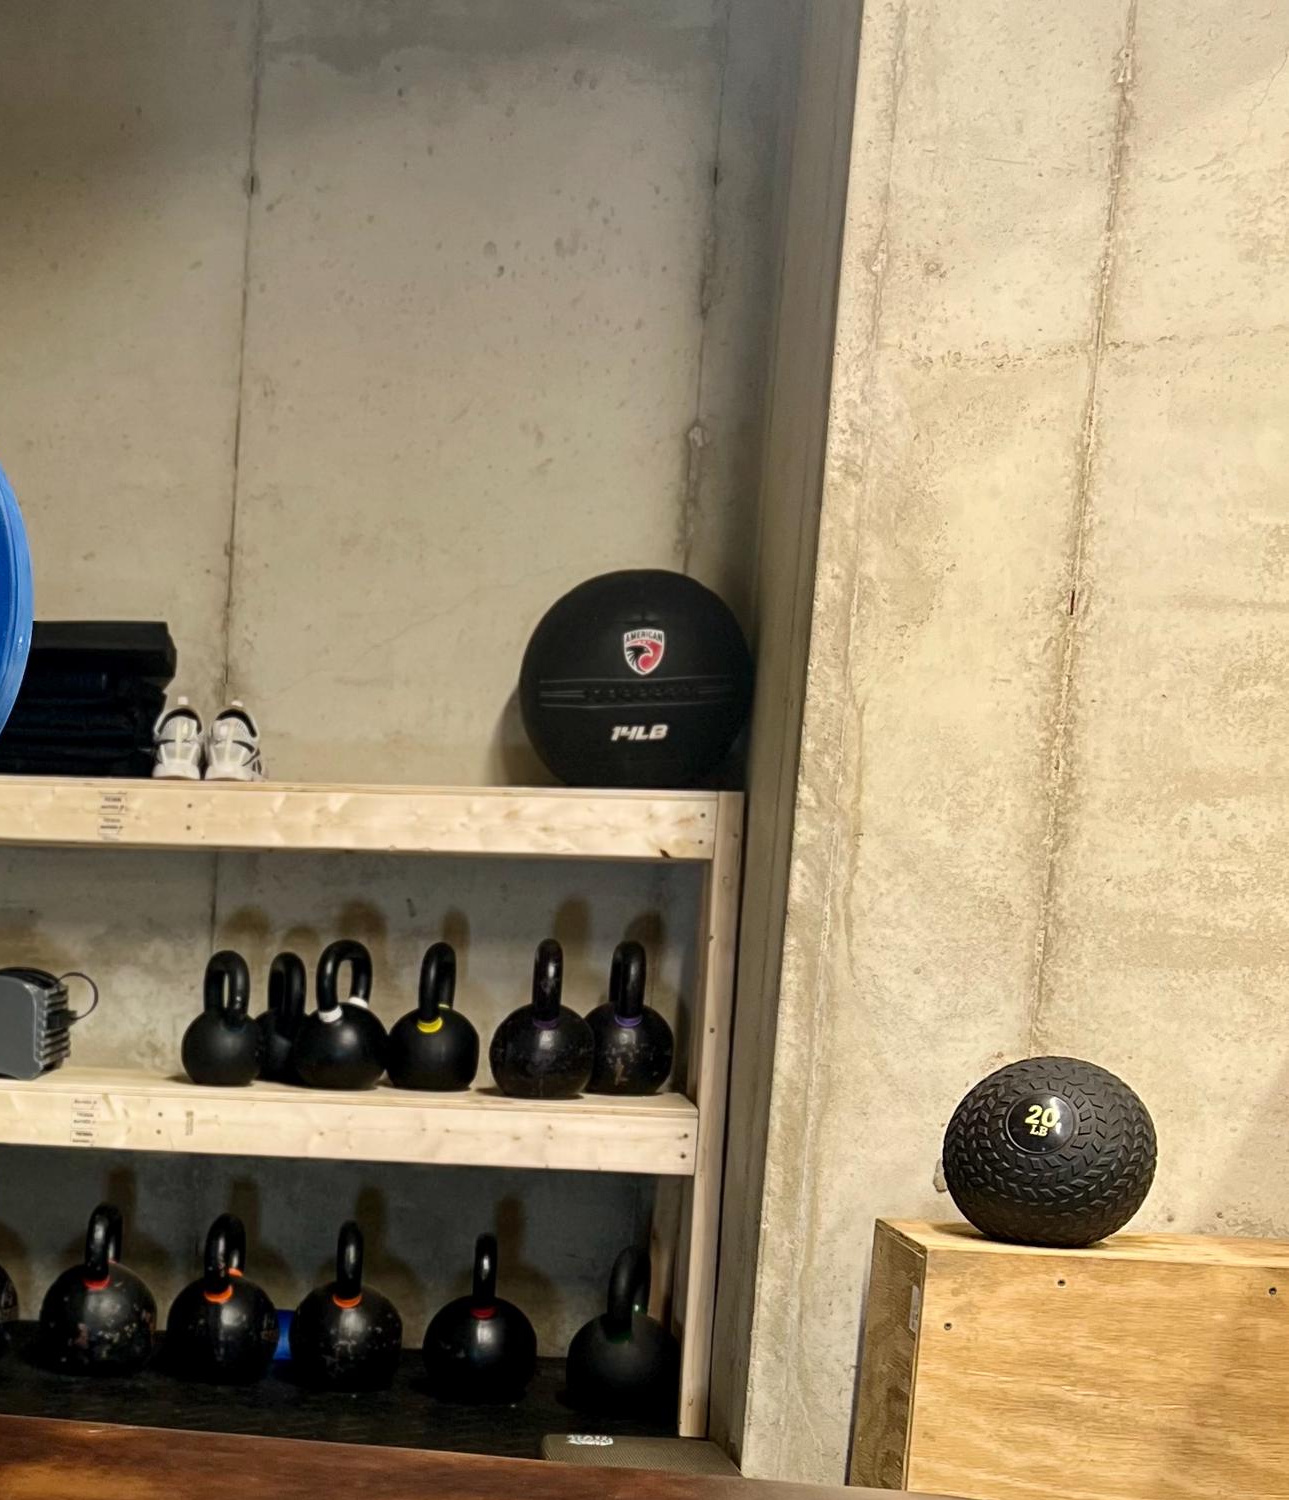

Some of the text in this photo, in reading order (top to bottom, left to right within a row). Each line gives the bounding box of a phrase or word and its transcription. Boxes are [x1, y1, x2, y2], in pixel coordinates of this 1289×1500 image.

[625, 630, 664, 643] AMERICAN
[610, 723, 669, 741] 14LB
[1024, 1104, 1061, 1129] 20
[1028, 1123, 1049, 1137] LB
